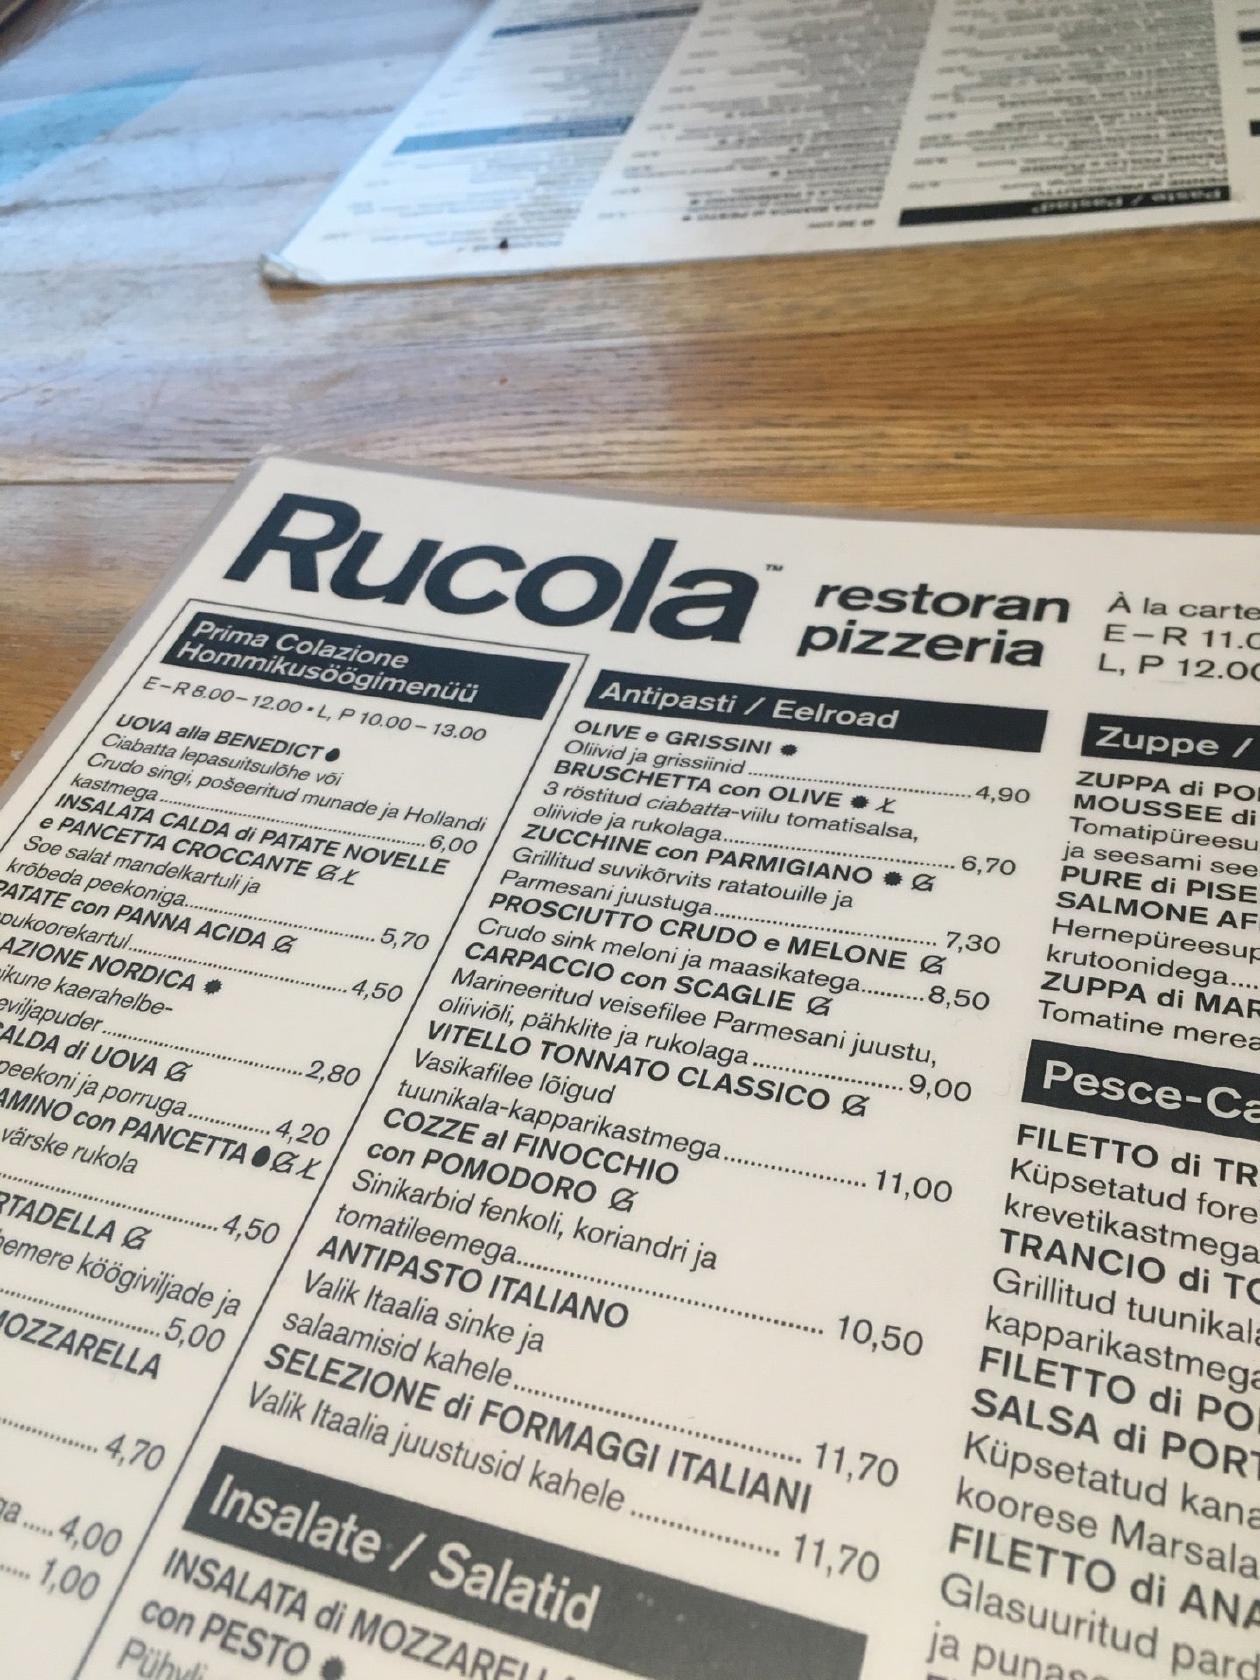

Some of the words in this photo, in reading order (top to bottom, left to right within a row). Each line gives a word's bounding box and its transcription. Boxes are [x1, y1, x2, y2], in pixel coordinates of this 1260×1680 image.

[223, 492, 759, 643] Rucola
[814, 583, 1070, 623] restoran
[176, 640, 479, 703] Hommikusöögimenüü
[192, 620, 269, 648] Prima
[275, 633, 409, 668] Colazione
[796, 620, 1043, 667] pizzeria
[598, 681, 737, 713] Antipasti
[772, 699, 899, 729] Eelroad
[101, 732, 177, 758] Ciabatta
[179, 746, 311, 781] lepasuitsulõhe
[115, 713, 172, 735] UOVA
[213, 730, 325, 760] BENEDICT
[574, 719, 641, 740] OLIVE
[665, 730, 772, 755] GRISSINI
[1095, 725, 1219, 757] Zuppe
[87, 752, 144, 775] Crudo
[146, 766, 192, 786] singi,
[195, 775, 301, 802] pošeeritud
[300, 793, 378, 815] munade
[403, 806, 486, 832] Hollandi
[553, 759, 711, 793] BRUSCHETTA
[768, 785, 843, 808] OLIVE
[563, 739, 627, 760] Oliivid
[652, 754, 746, 774] grissiinid
[975, 785, 1030, 804] 4,90
[1075, 770, 1171, 794] ZUPPA
[54, 792, 155, 823] INSALATA
[159, 811, 230, 838] CALDA
[258, 829, 341, 857] PATATE
[342, 843, 450, 875] NOVELLE
[69, 772, 158, 802] kastmega
[429, 834, 478, 855] 6,00
[562, 785, 642, 807] röstitud
[646, 797, 780, 824] ciabatta-viilu
[786, 812, 918, 843] tomatisalsa,
[1073, 793, 1222, 823] MOUSSEE
[56, 816, 167, 851] PANCETTA
[171, 838, 313, 877] CROCCANTE
[520, 823, 652, 856] ZUCCHINE
[704, 848, 873, 884] PARMIGIANO
[533, 803, 603, 825] oliivide
[631, 817, 722, 844] rukolaga
[961, 855, 1016, 876] 6,70
[1093, 848, 1201, 871] seesami
[112, 856, 241, 889] mandelkartuli
[512, 846, 596, 872] Grillitud
[598, 863, 711, 889] suvikõrvits
[717, 879, 828, 905] ratatouille
[1060, 864, 1142, 891] PURE
[5, 857, 83, 886] krõbeda
[82, 877, 186, 908] peekoniga
[380, 927, 430, 950] 5,70
[113, 903, 192, 934] PANNA
[193, 920, 266, 949] ACIDA
[488, 892, 653, 933] PROSCIUTTO
[659, 918, 757, 948] CRUDO
[786, 935, 908, 970] MELONE
[499, 869, 613, 900] Parmesani
[613, 891, 712, 918] juustuga
[946, 930, 1001, 954] 7,30
[1055, 890, 1208, 926] SALMONE
[87, 954, 196, 992] NORDICA
[351, 979, 403, 1003] 4,50
[464, 941, 615, 982] CARPACCIO
[620, 971, 667, 991] con
[673, 975, 796, 1012] SCAGLIE
[477, 917, 546, 943] Crudo
[600, 941, 677, 964] meloni
[708, 957, 860, 995] maasikatega
[927, 985, 990, 1011] 8,50
[1040, 970, 1146, 1004] ZUPPA
[1046, 943, 1229, 988] krutoonidega
[52, 975, 173, 1015] kaerahelbe-
[450, 967, 594, 1007] Marineeritud
[599, 996, 706, 1027] veisefilee
[712, 1010, 845, 1049] Parmesani
[848, 1038, 936, 1068] juustu,
[1038, 999, 1164, 1036] Tomatine
[90, 1044, 158, 1076] UOVA
[304, 1059, 361, 1086] 2,80
[415, 1047, 533, 1089] Vasikafilee
[538, 1072, 616, 1104] lõigud
[428, 1020, 532, 1056] VITELLO
[540, 1040, 670, 1082] TONNATO
[677, 1066, 830, 1110] CLASSICO
[438, 996, 514, 1027] oliiviõli,
[520, 1012, 612, 1040] pähklite
[644, 1032, 748, 1068] rukolaga
[909, 1073, 972, 1102] 9,00
[72, 1110, 116, 1133] con
[118, 1115, 247, 1164] PANCETTA
[97, 1085, 187, 1118] porruga
[275, 1119, 330, 1146] 4,20
[397, 1079, 721, 1161] tuunikala-kapparikastmega
[877, 1169, 953, 1203] 11,00
[1, 1126, 69, 1157] värske
[71, 1144, 138, 1174] rukola
[366, 1143, 416, 1166] con
[420, 1148, 597, 1203] POMODORO
[383, 1107, 480, 1145] COZZE
[512, 1132, 679, 1185] FINOCCHIO
[1016, 1123, 1158, 1169] FILETTO
[1010, 1157, 1187, 1211] Küpsetatud
[222, 1214, 280, 1244] 4,50
[351, 1168, 476, 1215] Sinikarbid
[478, 1196, 563, 1240] fenkoli,
[572, 1216, 687, 1263] koriandri
[76, 1252, 214, 1308] köögiviljade
[316, 1235, 483, 1293] ANTIPASTO
[488, 1274, 629, 1328] ITALIANO
[336, 1203, 516, 1266] tomatileemega
[839, 1315, 923, 1356] 10,50
[999, 1227, 1166, 1284] TRANCIO
[304, 1269, 360, 1305] Valik
[363, 1284, 439, 1326] Itaalia
[444, 1312, 515, 1343] sinke
[992, 1267, 1116, 1315] Grillitud
[164, 1317, 226, 1353] 5,00
[282, 1311, 420, 1364] salaamisid
[424, 1347, 513, 1388] kahele
[813, 1442, 900, 1487] 11,70
[979, 1345, 1135, 1405] FILETTO
[1149, 1385, 1182, 1417] di
[263, 1343, 440, 1411] SELEZIONE
[478, 1399, 660, 1472] FORMAGGI
[667, 1448, 812, 1513] ITALIANI
[970, 1388, 1099, 1444] SALSA
[1113, 1423, 1146, 1454] di
[105, 1433, 166, 1471] 4,70
[963, 1430, 1167, 1506] Küpsetatud
[248, 1381, 305, 1421] Valik
[311, 1398, 389, 1448] Itaalia
[392, 1425, 523, 1481] juustusid
[529, 1467, 626, 1513] kahele
[793, 1534, 881, 1583] 11,70
[956, 1476, 1097, 1538] koorese
[59, 1516, 122, 1556] 4,00
[209, 1474, 381, 1562] Insalate
[389, 1532, 429, 1572] /
[429, 1541, 601, 1633] Salatid
[949, 1522, 1116, 1593] FILETTO
[1130, 1572, 1165, 1607] di
[41, 1559, 100, 1600] 1,00
[162, 1547, 310, 1622] INSALATA
[314, 1602, 348, 1632] di
[927, 1621, 959, 1663] ja
[940, 1572, 1158, 1658] Glasuuritud
